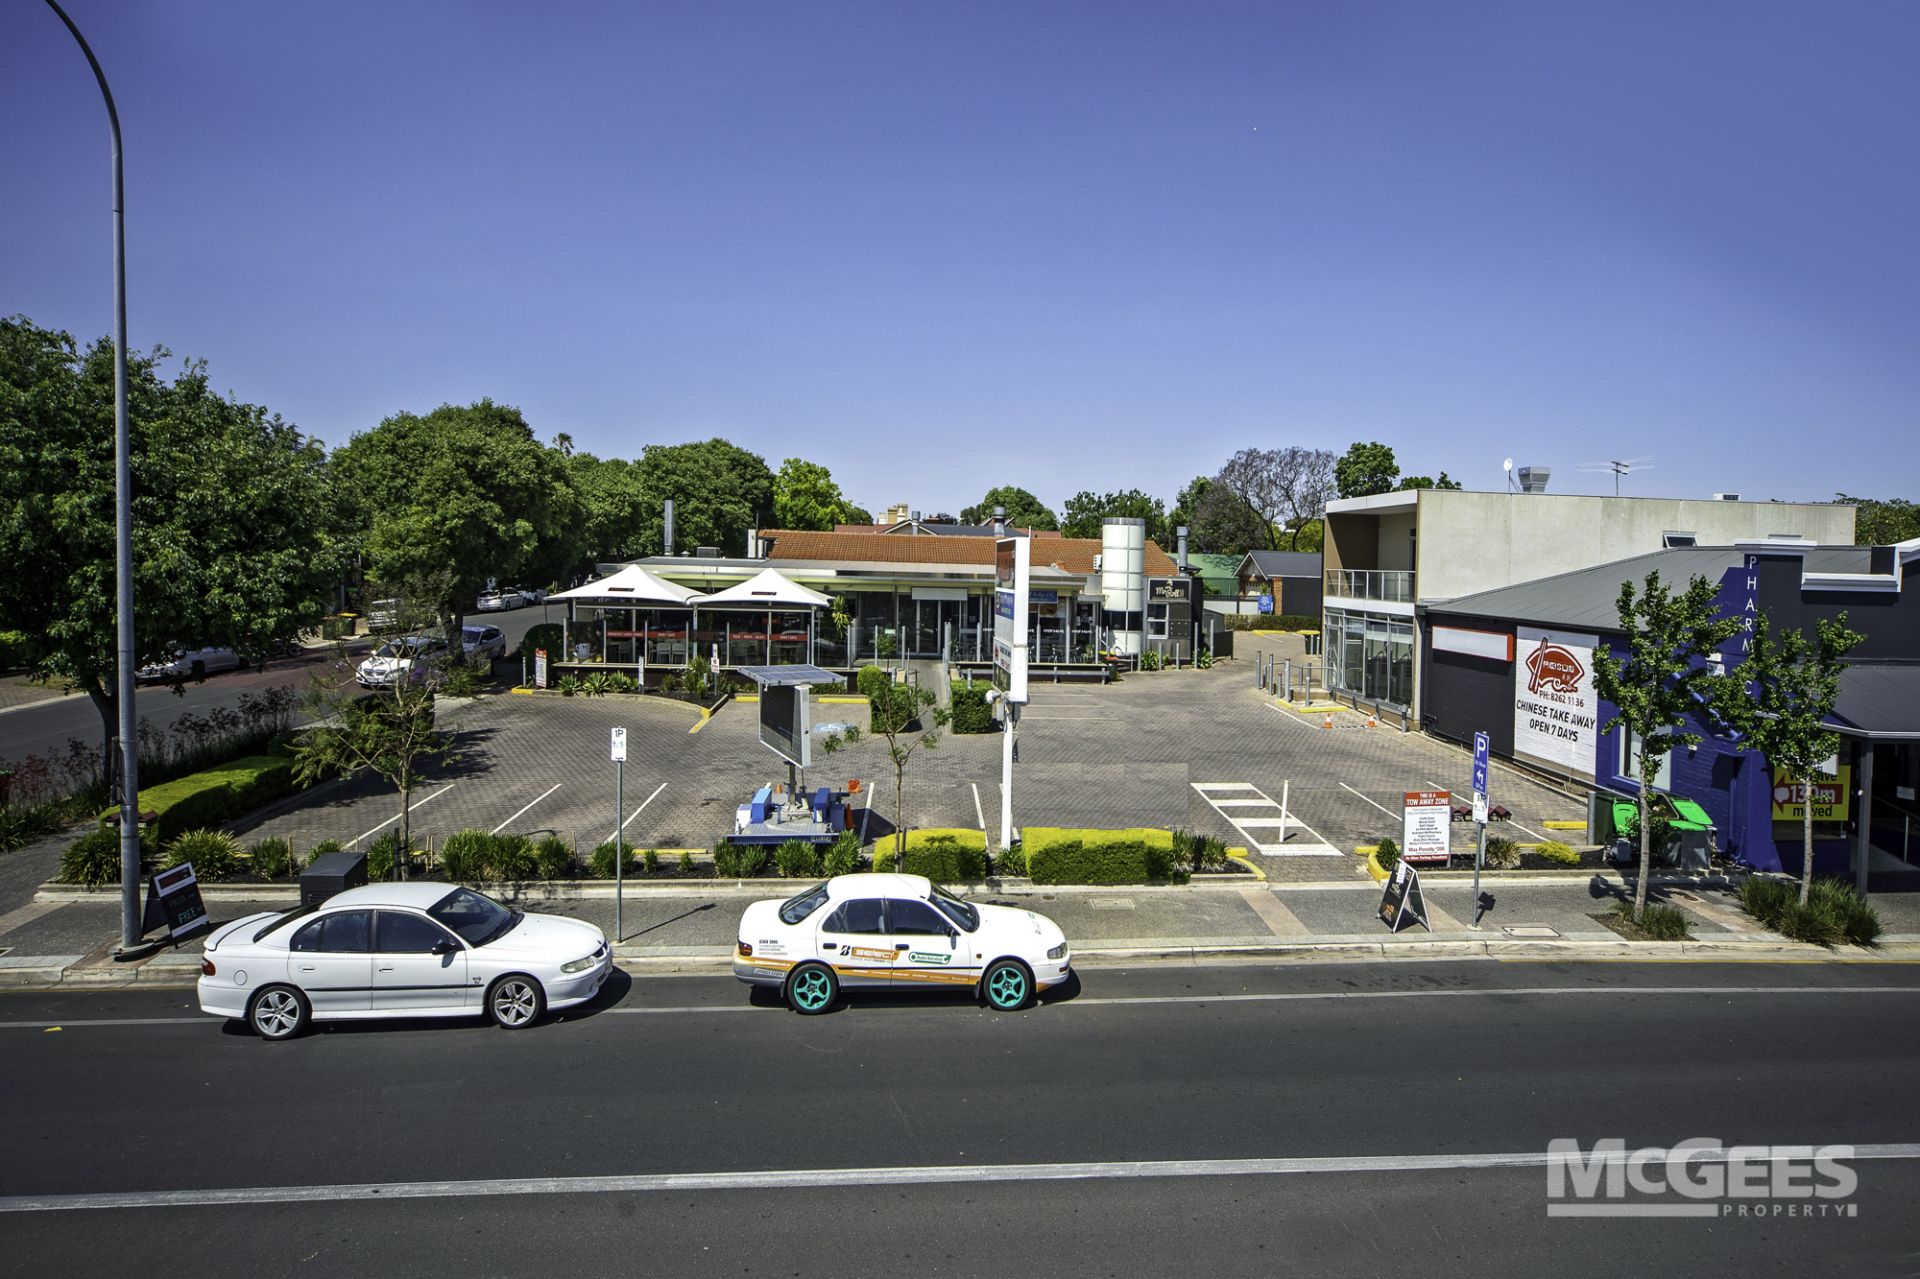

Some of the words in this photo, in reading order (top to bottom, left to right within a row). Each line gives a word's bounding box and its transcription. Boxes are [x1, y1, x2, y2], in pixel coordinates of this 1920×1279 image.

[1742, 555, 1758, 695] PHARMC
[1550, 693, 1566, 704] 8262
[1516, 699, 1548, 717] CHINESE
[1549, 707, 1569, 723] TAKE
[1570, 713, 1596, 730] AWAY
[1529, 718, 1549, 733] OPEN
[1551, 724, 1556, 736] 7
[1557, 726, 1578, 742] DAYS
[1476, 737, 1487, 758] P
[1793, 805, 1833, 817] mved
